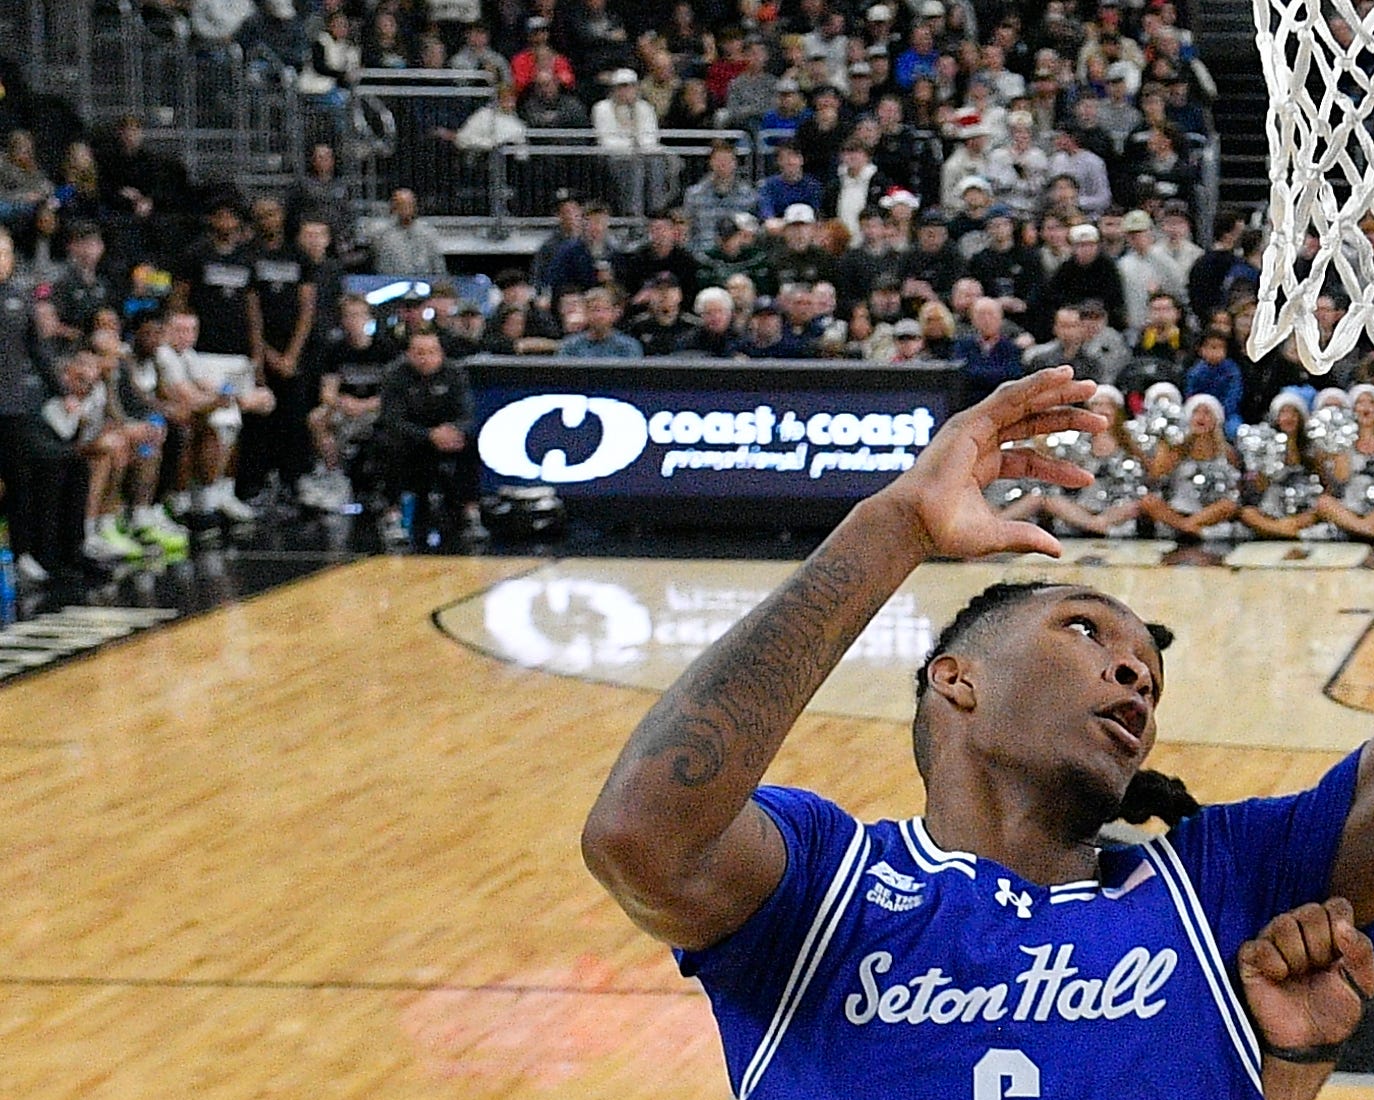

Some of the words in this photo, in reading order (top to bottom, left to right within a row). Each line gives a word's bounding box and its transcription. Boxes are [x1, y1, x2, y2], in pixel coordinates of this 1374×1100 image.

[649, 405, 775, 444] coast
[806, 407, 934, 446] coast
[845, 951, 1008, 1025] Seton
[1013, 943, 1178, 1022] Hall
